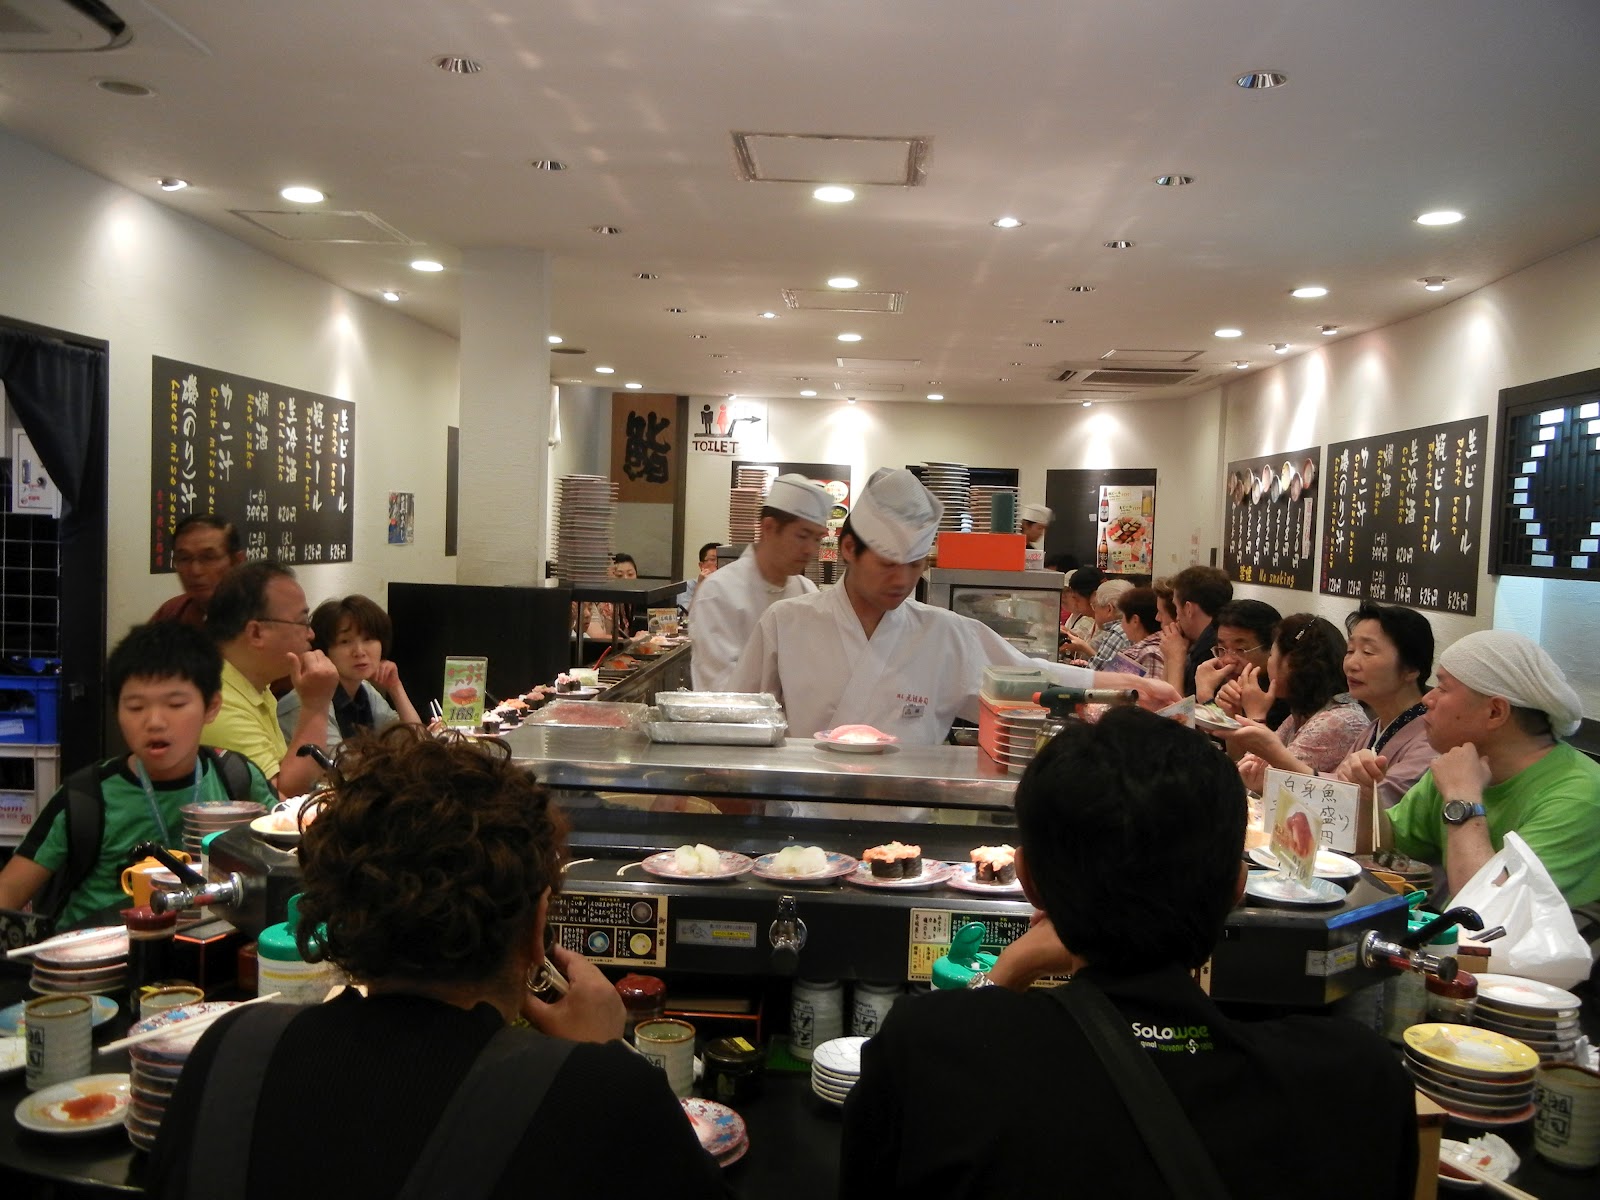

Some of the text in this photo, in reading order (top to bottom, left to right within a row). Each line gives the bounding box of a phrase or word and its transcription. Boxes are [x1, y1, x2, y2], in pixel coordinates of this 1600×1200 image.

[247, 393, 255, 424] Hot
[278, 401, 286, 439] Cold
[218, 382, 234, 482] カニ汁
[286, 397, 298, 483] 生冷酒
[692, 440, 739, 454] TOILET
[312, 401, 325, 513] 瓶ビール
[338, 409, 349, 514] 生ビール
[1356, 446, 1369, 526] カニ汁
[1404, 438, 1419, 524] 生冷酒
[1430, 432, 1448, 554] 瓶ビール
[1460, 428, 1478, 555] 生ビール
[168, 492, 178, 534] soup
[246, 505, 269, 522] 399円
[278, 506, 296, 522] 420円
[1282, 498, 1292, 556] 168円
[1452, 496, 1460, 536] beer
[1272, 508, 1281, 566] 210円
[1422, 516, 1430, 552] beer
[304, 544, 322, 561] 525円
[330, 544, 347, 560] 525円
[1372, 546, 1388, 562] 399円
[1396, 547, 1414, 564] 420円
[1258, 568, 1267, 582] No
[1268, 570, 1295, 588] smoking
[1419, 586, 1438, 606] 525円
[1448, 590, 1468, 612] 525円
[1284, 776, 1337, 803] 白身魚
[1320, 806, 1350, 832] 盛り
[1321, 830, 1333, 844] 円
